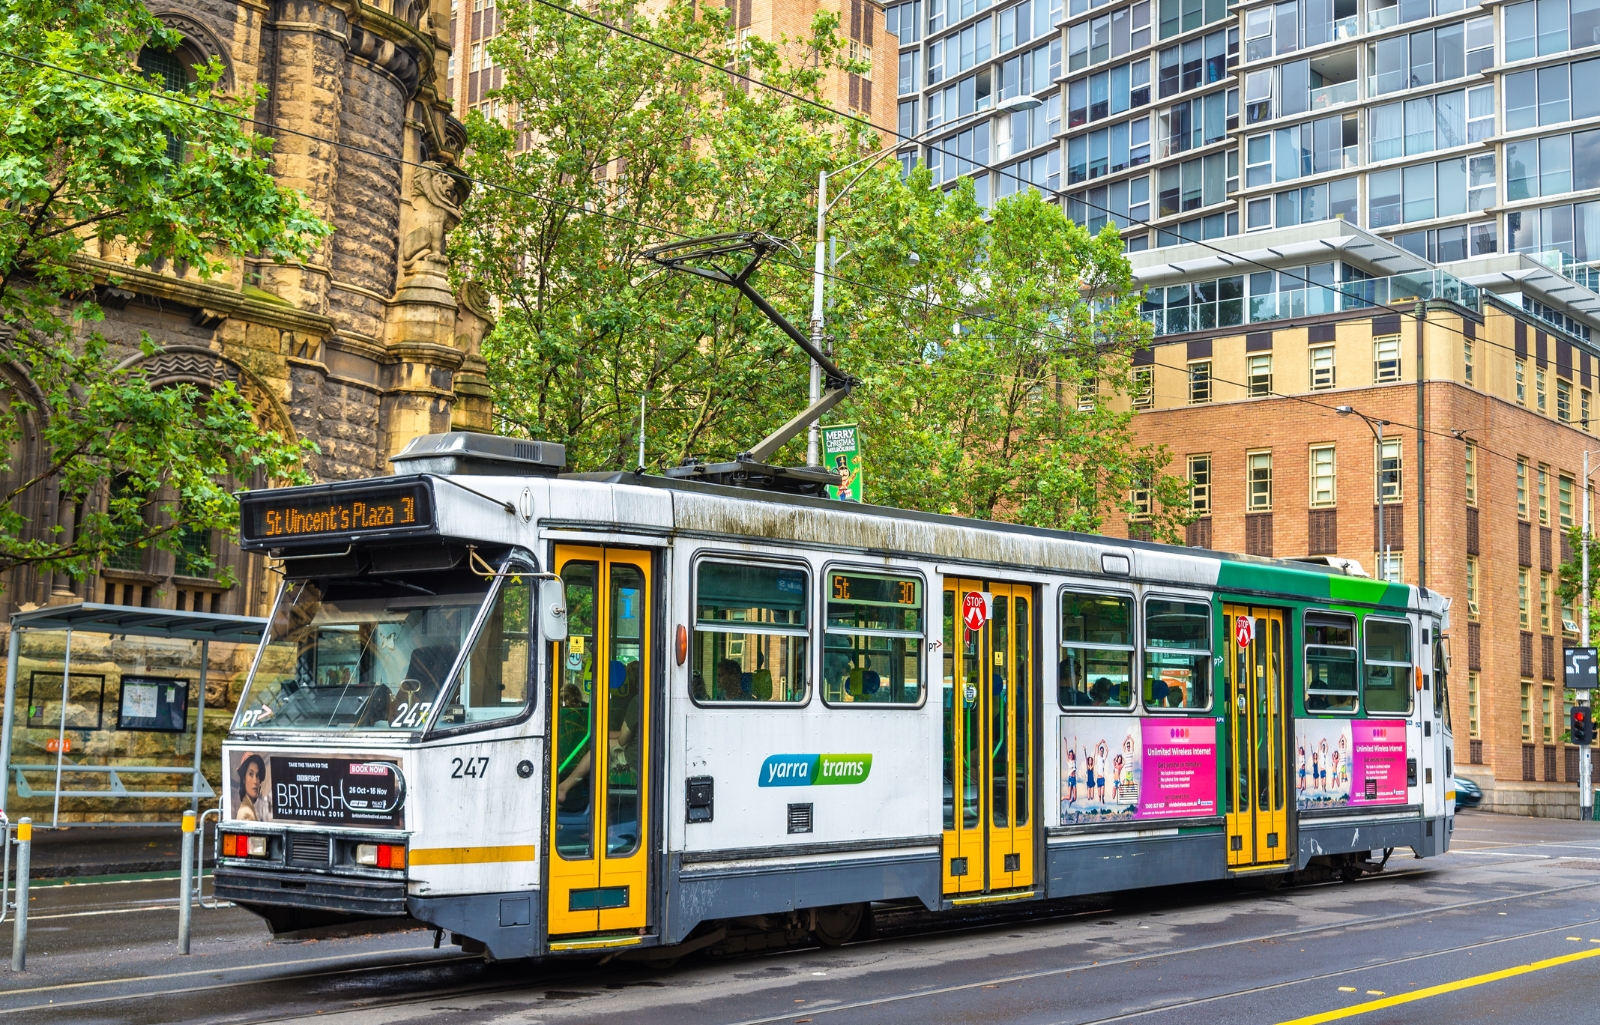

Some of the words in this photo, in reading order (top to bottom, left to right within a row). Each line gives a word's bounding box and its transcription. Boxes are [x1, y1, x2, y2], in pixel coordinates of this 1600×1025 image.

[826, 430, 854, 440] MERRY
[826, 438, 855, 447] CHRISTMAS
[266, 510, 282, 535] St
[286, 506, 350, 534] Vincent's
[353, 502, 394, 528] Plaza
[834, 576, 850, 599] St
[898, 581, 914, 604] 30
[967, 596, 983, 607] STOP
[1238, 620, 1249, 628] STOP
[391, 703, 432, 728] 247
[1148, 748, 1171, 756] Unlimited
[452, 758, 489, 779] 247
[768, 762, 808, 782] yarra
[823, 759, 863, 776] trams
[277, 783, 344, 809] BRITISH
